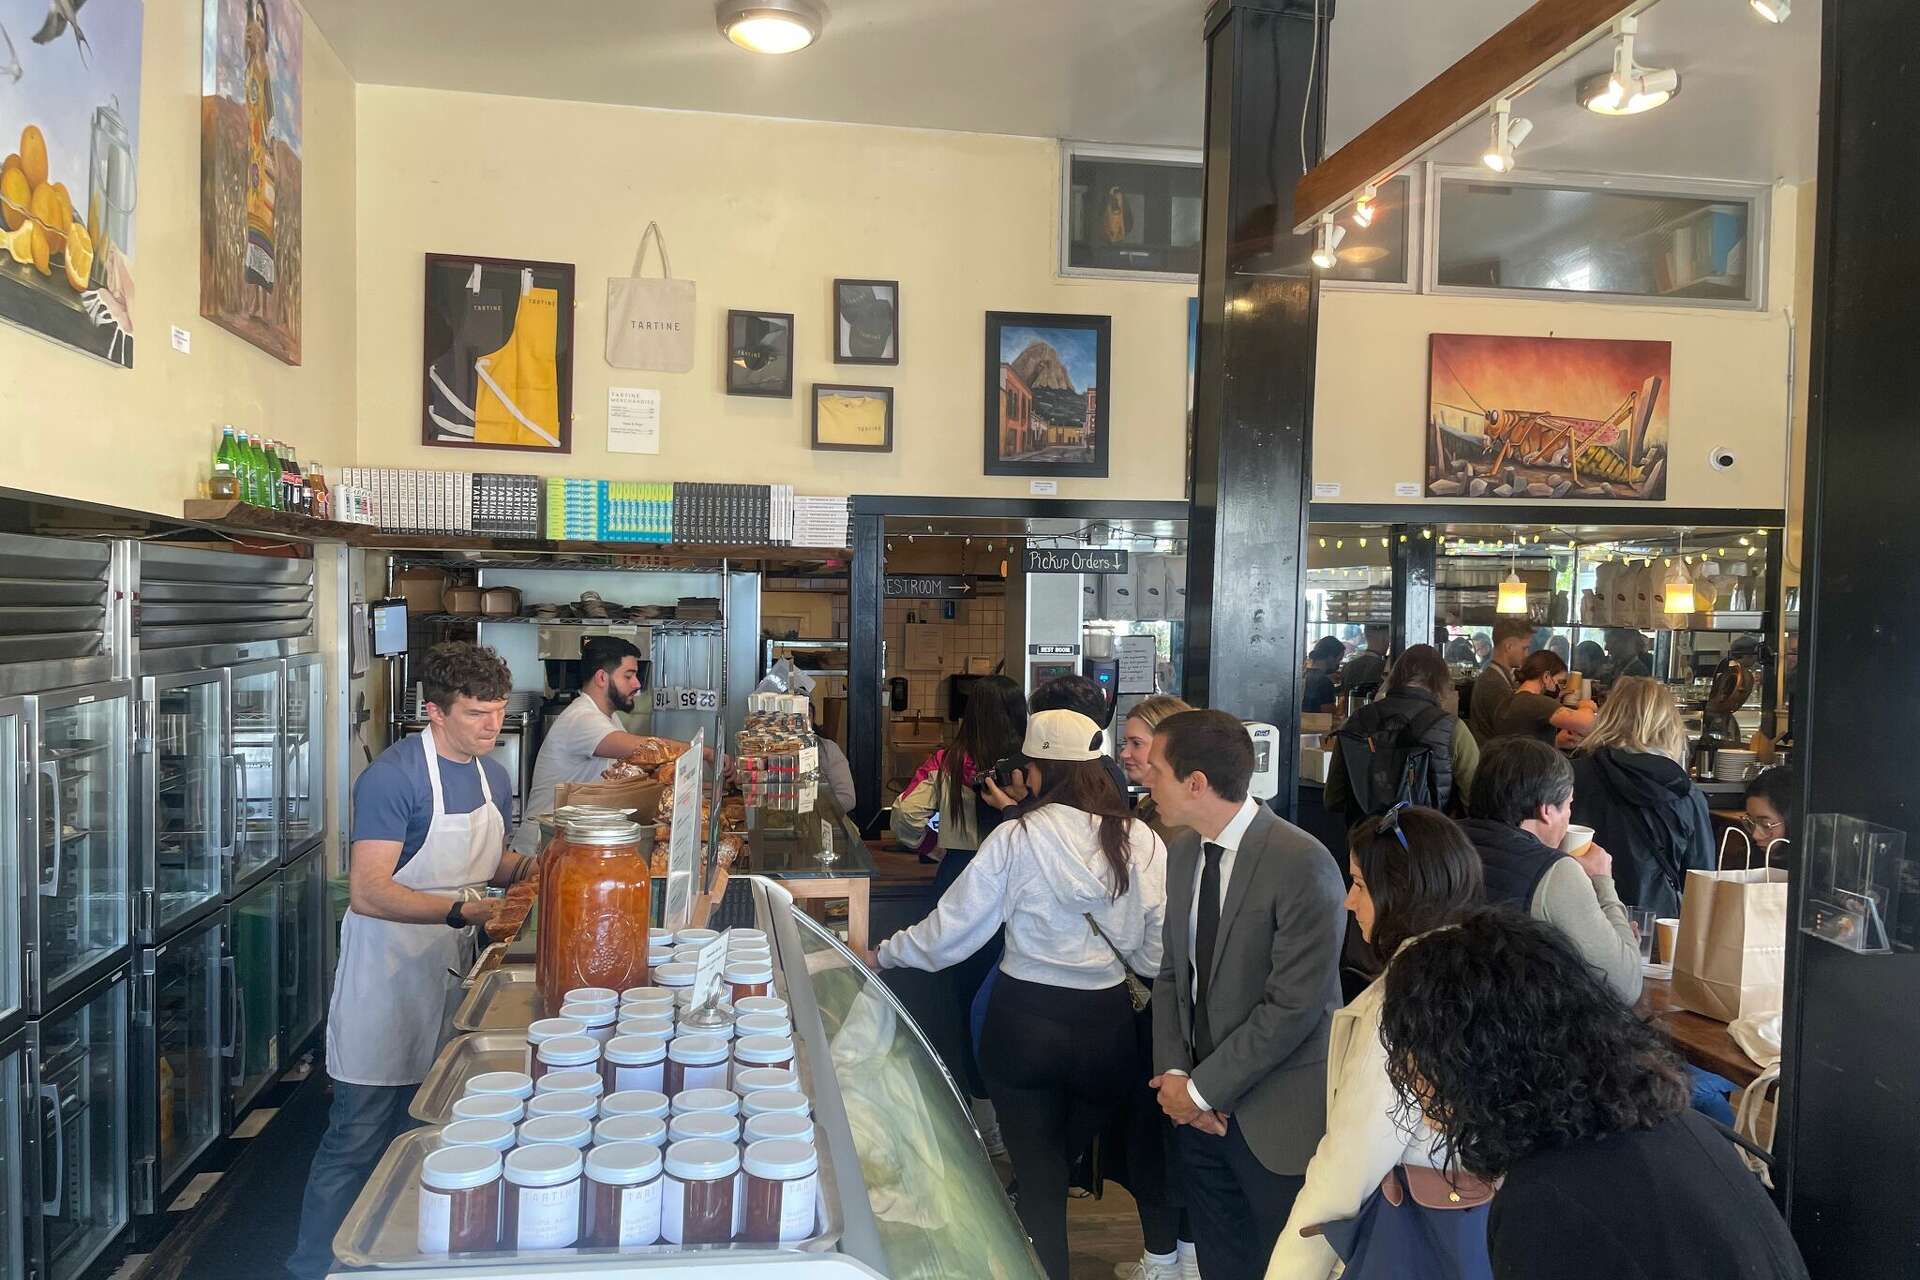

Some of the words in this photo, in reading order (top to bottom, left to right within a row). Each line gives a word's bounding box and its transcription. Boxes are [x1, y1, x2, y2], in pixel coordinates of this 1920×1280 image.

[632, 320, 680, 331] TARTINE
[1029, 551, 1070, 570] Pickup
[1072, 552, 1110, 570] Orders
